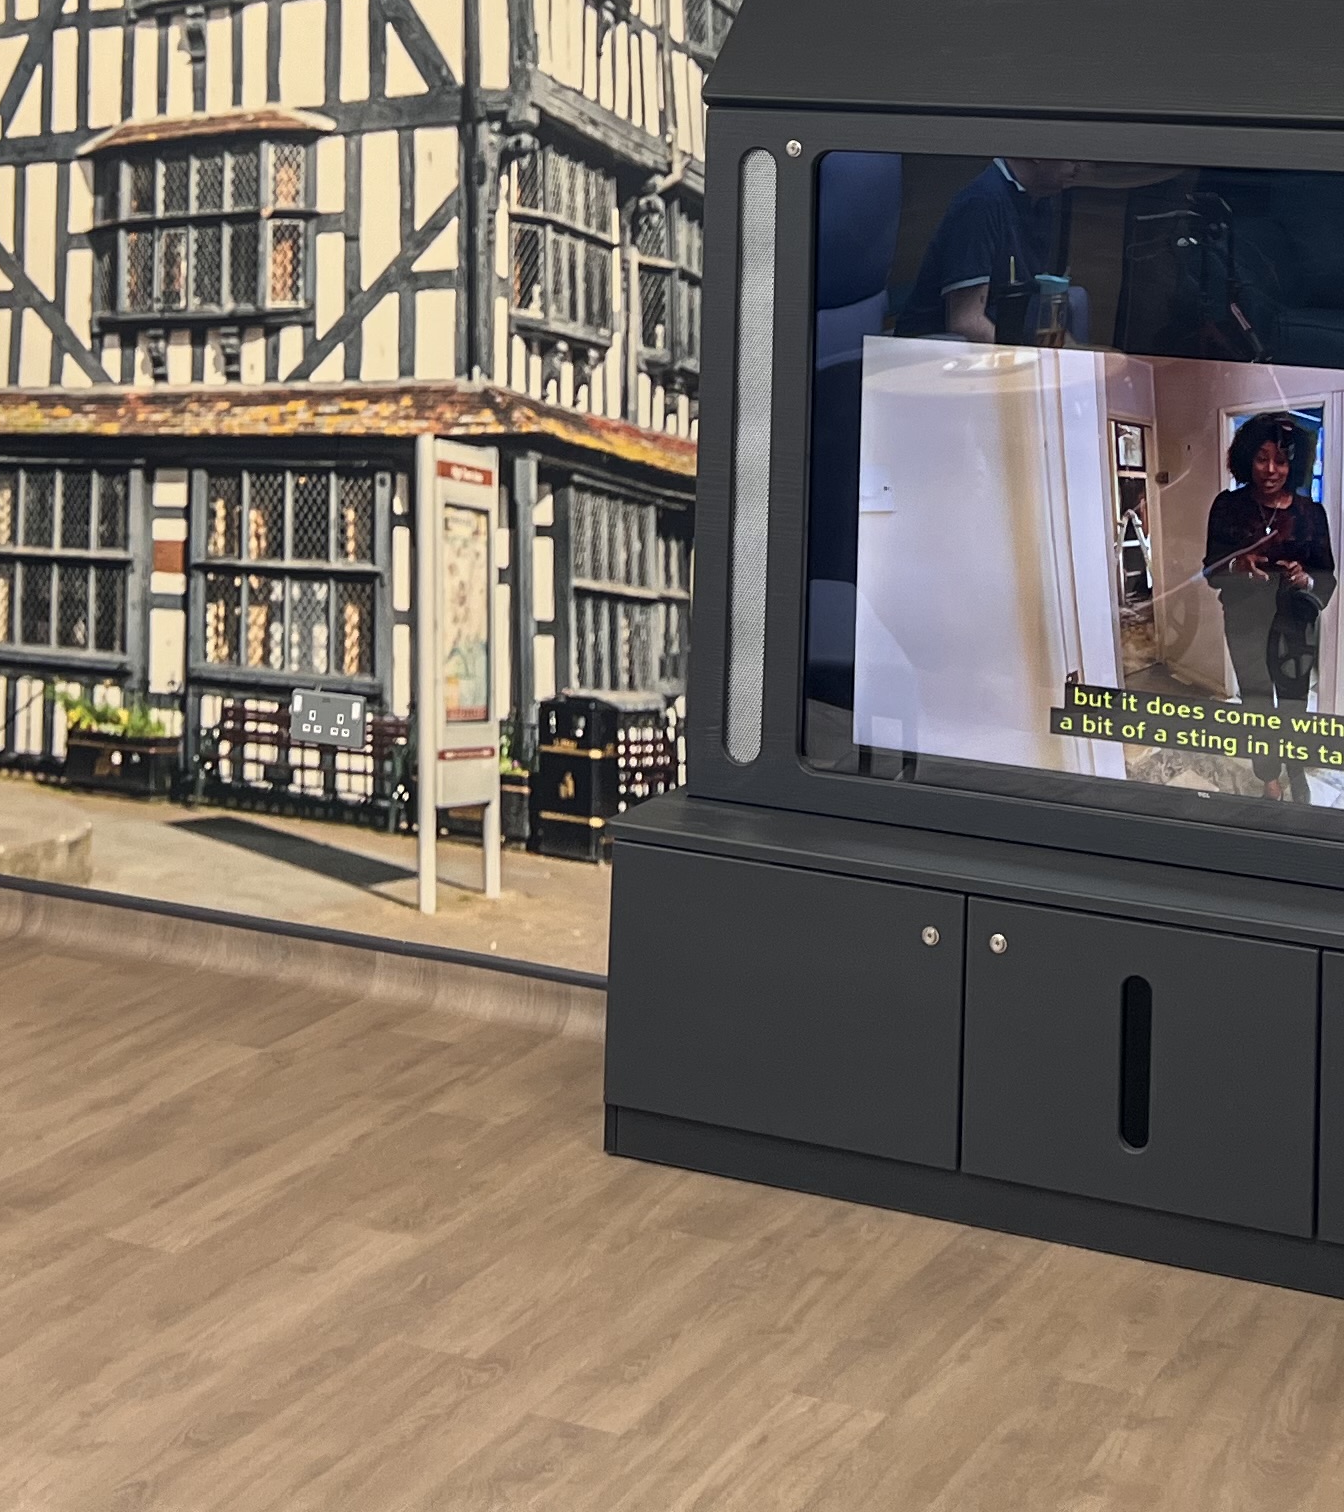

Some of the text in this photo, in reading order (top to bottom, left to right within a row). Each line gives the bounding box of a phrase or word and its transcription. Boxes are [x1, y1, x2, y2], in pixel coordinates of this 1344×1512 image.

[1074, 687, 1344, 737] but it does come with
[1059, 717, 1073, 730] a
[1083, 715, 1113, 736] bit
[1122, 721, 1145, 739] of
[1154, 728, 1167, 743] a
[1176, 729, 1237, 757] sting
[1247, 736, 1269, 756] in
[1279, 740, 1309, 761] its
